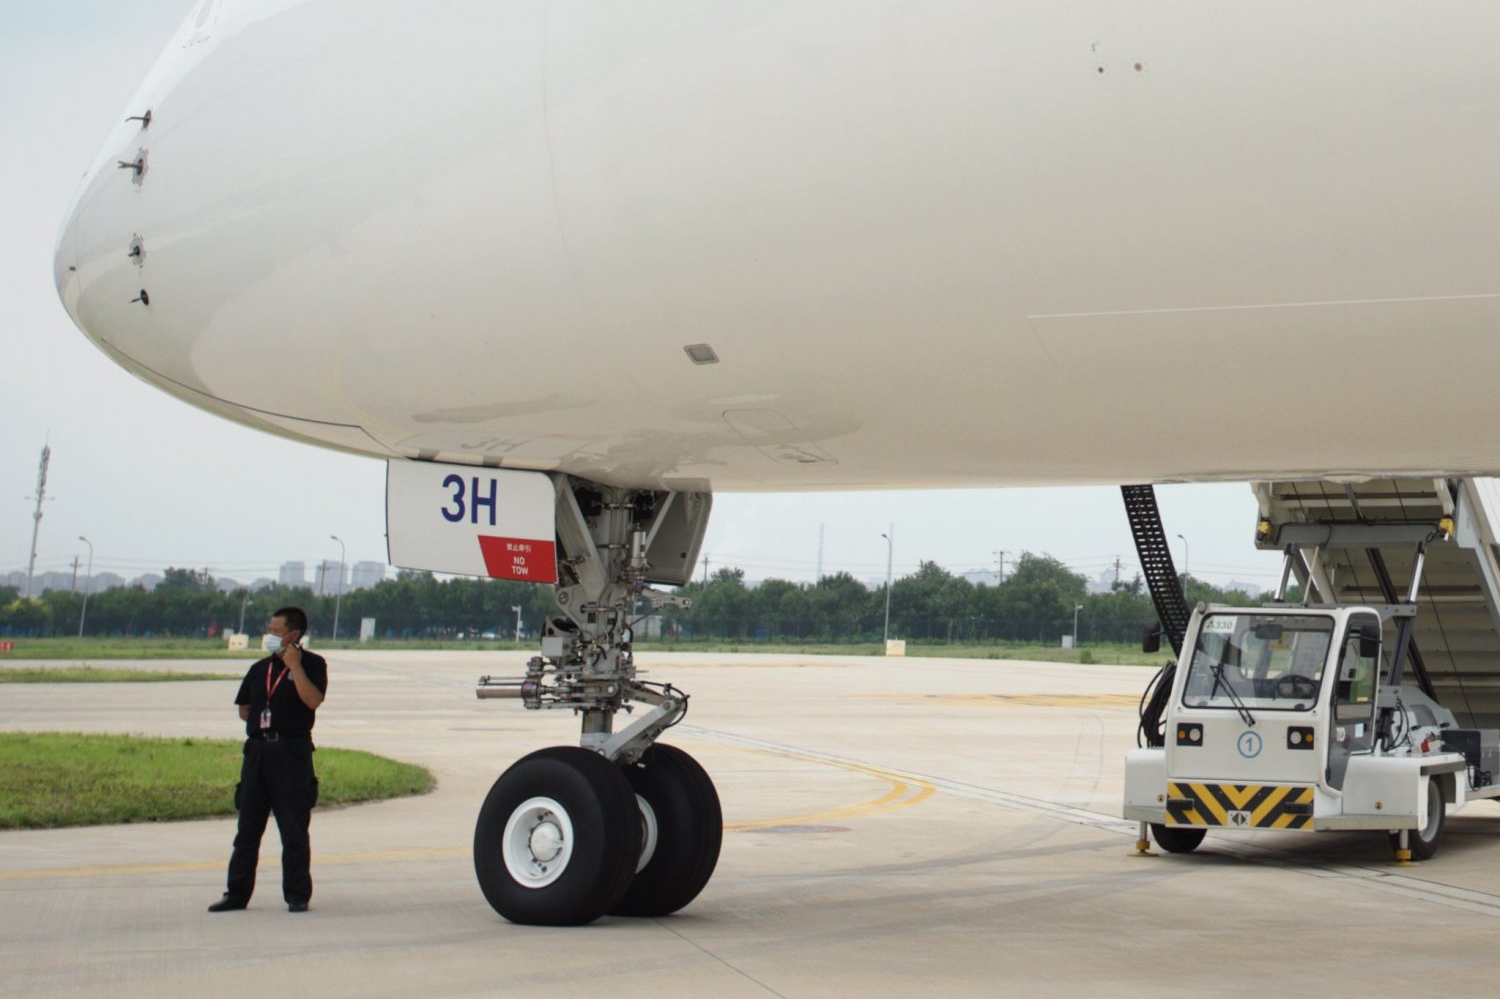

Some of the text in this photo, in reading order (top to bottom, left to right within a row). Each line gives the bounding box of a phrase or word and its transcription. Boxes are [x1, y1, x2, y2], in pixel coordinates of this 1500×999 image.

[441, 474, 497, 526] 3H
[513, 556, 526, 566] NO
[511, 565, 529, 576] TOW
